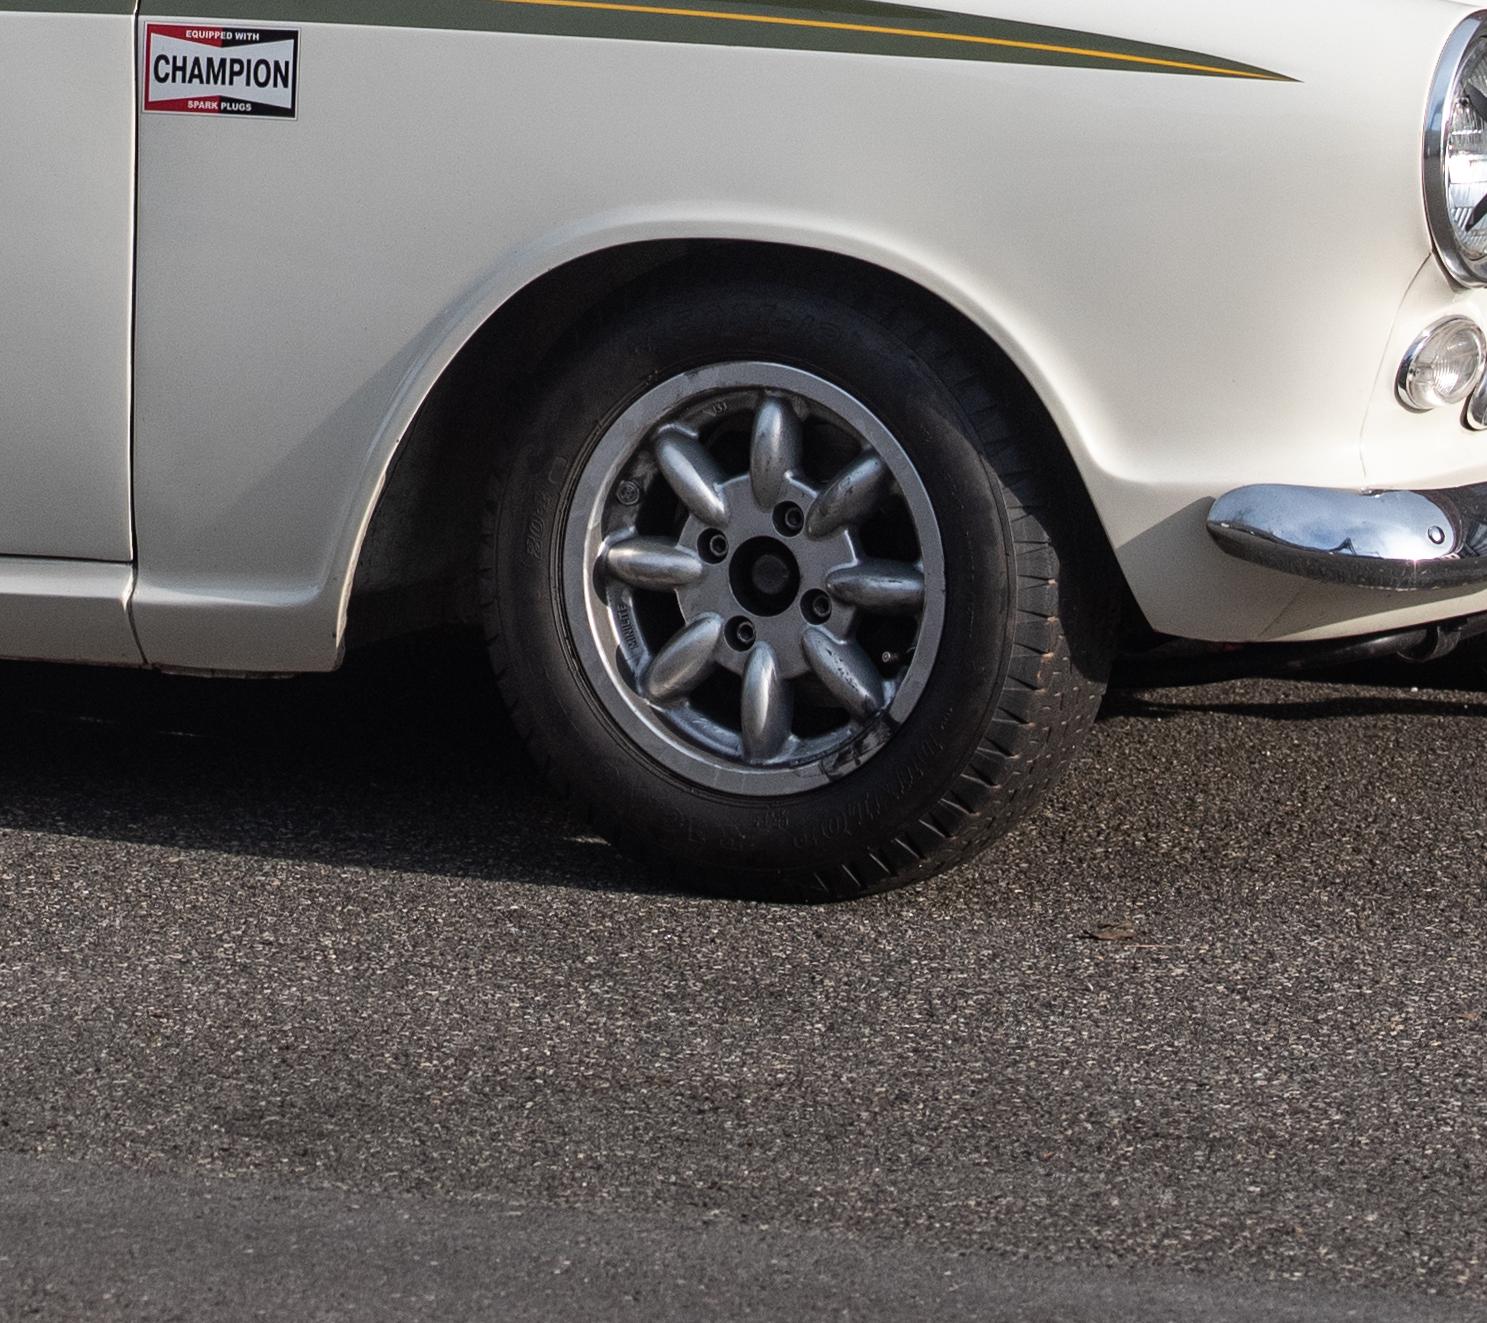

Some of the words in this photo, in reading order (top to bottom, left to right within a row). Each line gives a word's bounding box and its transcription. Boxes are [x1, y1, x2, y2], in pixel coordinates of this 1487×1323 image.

[185, 29, 233, 40] EQUIPPED
[235, 32, 261, 41] WITH
[153, 53, 291, 90] CHAMPION
[187, 100, 219, 110] SPARK
[220, 102, 253, 112] PLUGS
